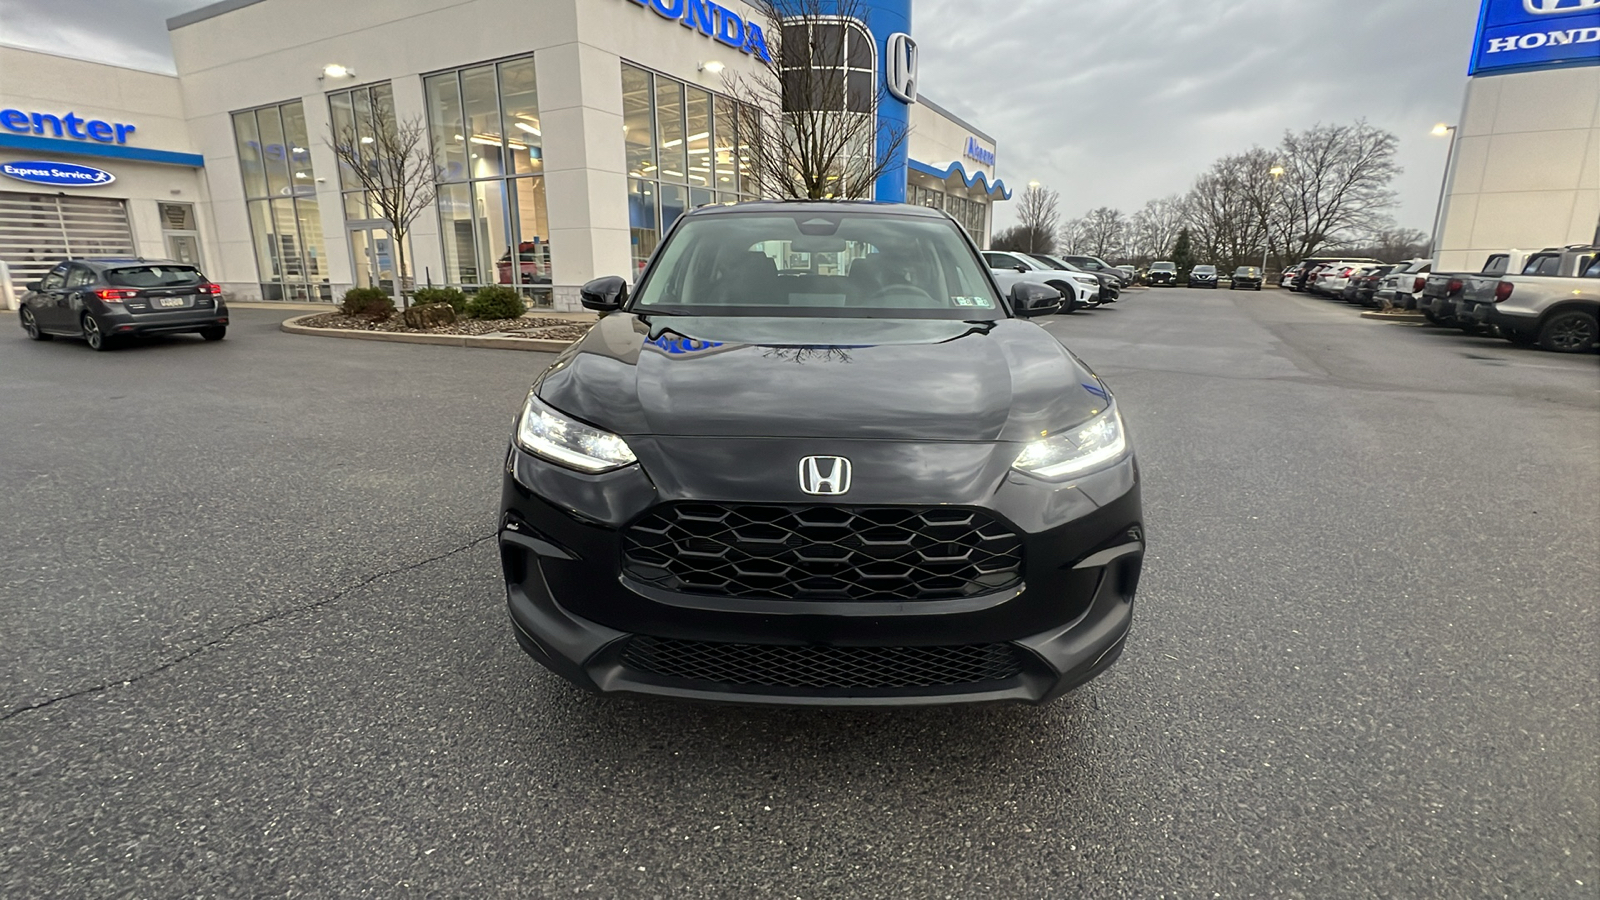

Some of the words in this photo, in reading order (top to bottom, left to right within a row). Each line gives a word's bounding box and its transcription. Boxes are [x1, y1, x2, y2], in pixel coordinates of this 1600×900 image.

[1486, 27, 1600, 53] HOND
[0, 109, 136, 144] enter
[4, 165, 50, 176] Express
[51, 169, 92, 180] Service
